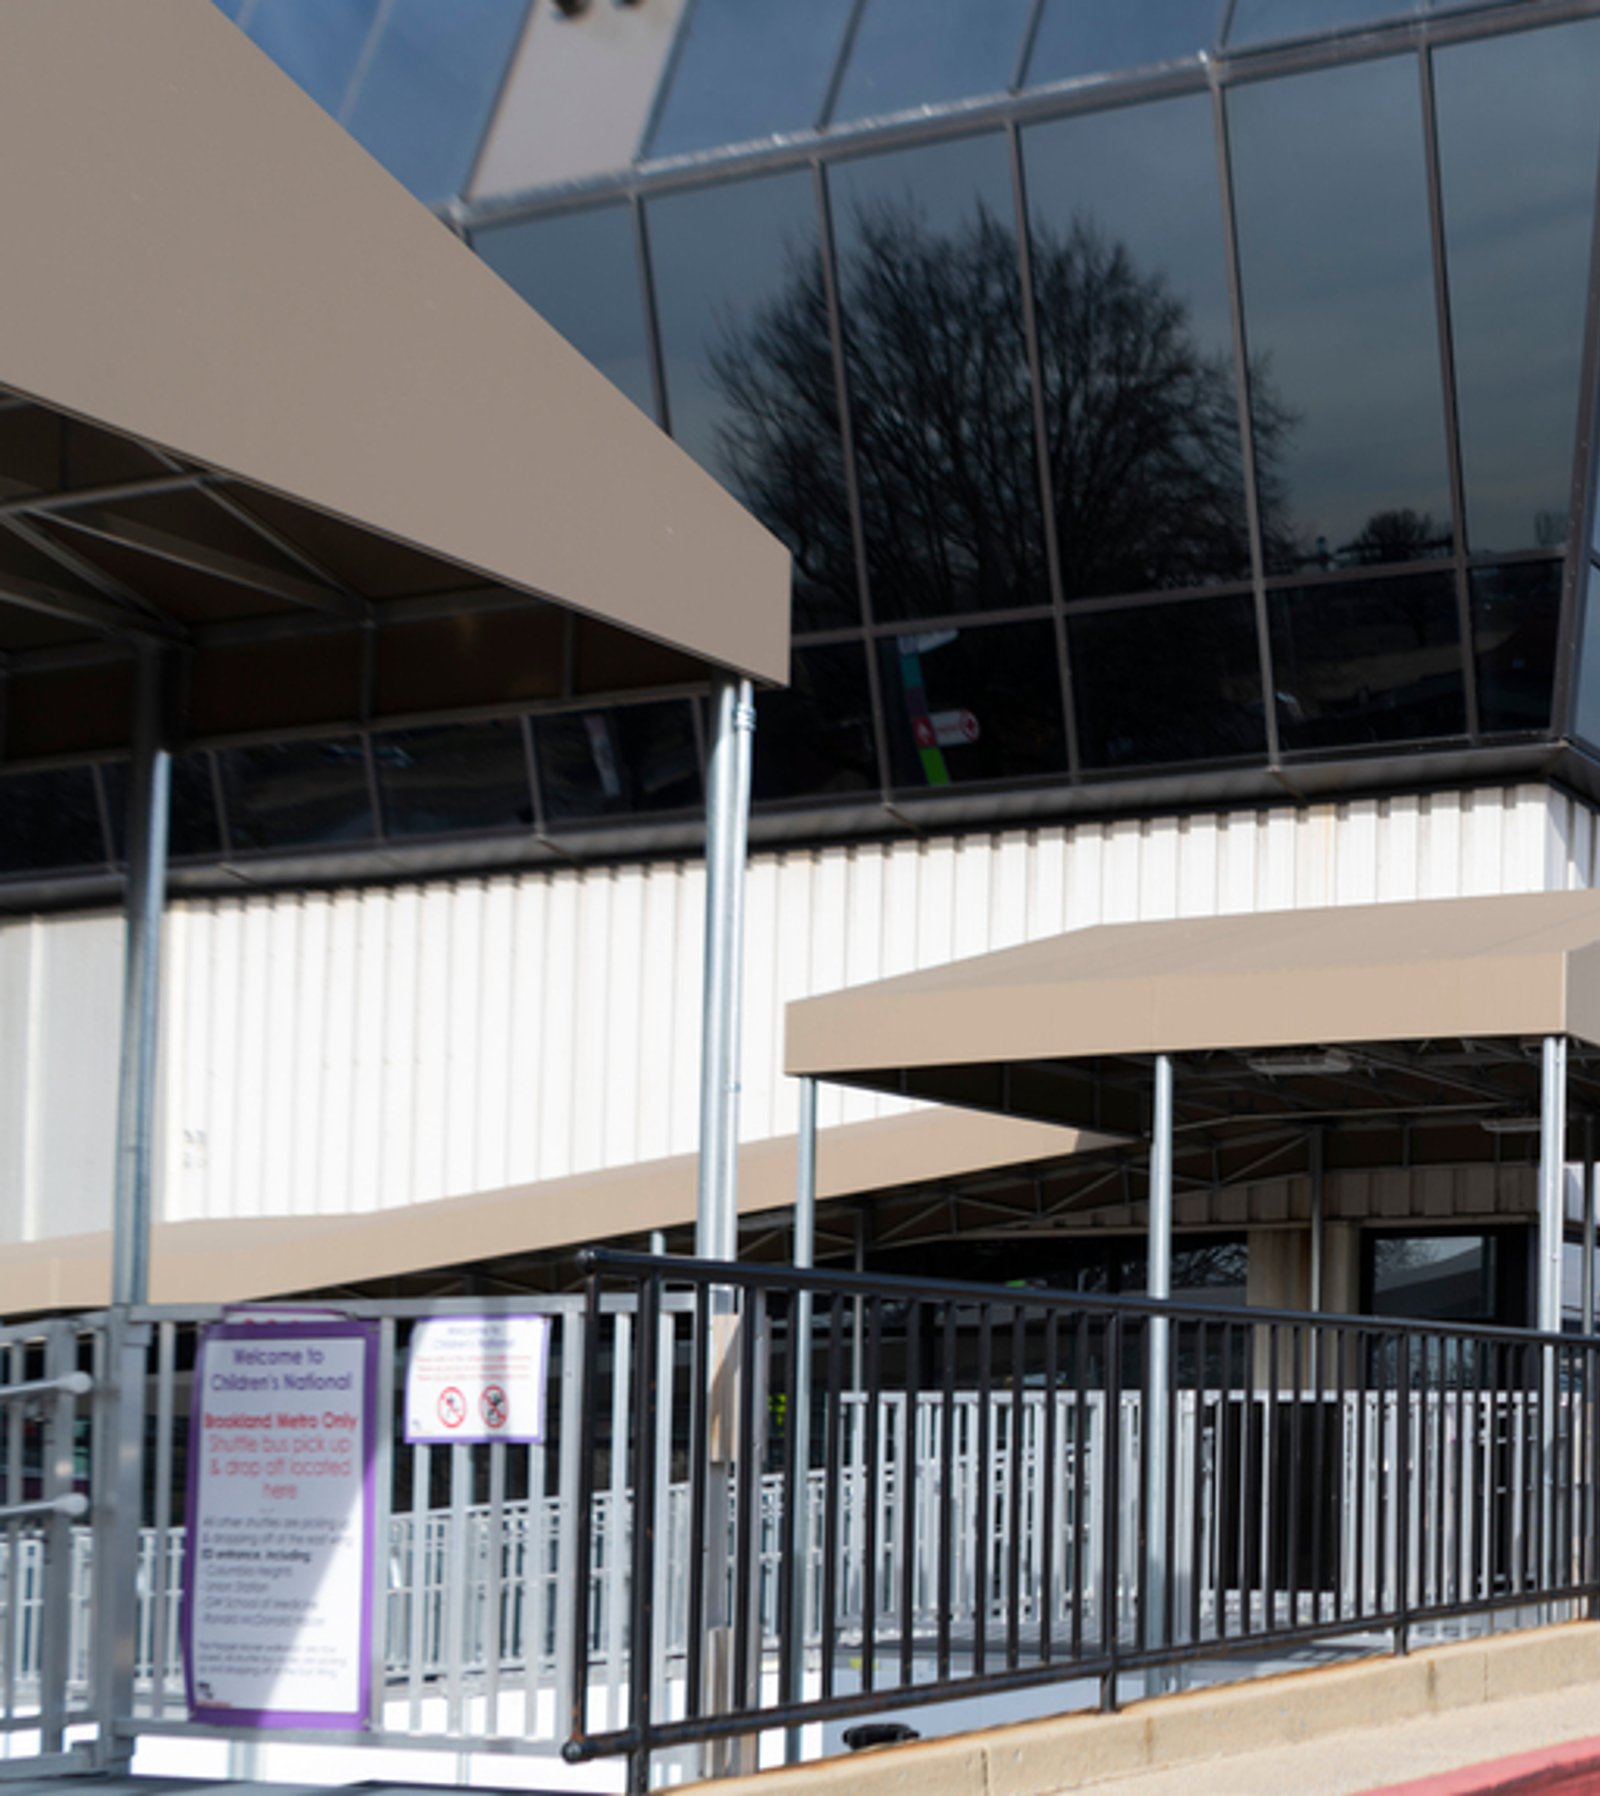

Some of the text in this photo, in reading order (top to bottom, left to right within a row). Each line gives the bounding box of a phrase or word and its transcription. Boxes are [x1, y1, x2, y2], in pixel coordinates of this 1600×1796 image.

[233, 1345, 325, 1365] Welcome to
[210, 1371, 352, 1391] Children's National
[205, 1411, 358, 1432] Brookland Metro Only
[208, 1433, 352, 1456] Shuttle bus pick up
[209, 1457, 352, 1480] & drop off located
[262, 1482, 298, 1500] here
